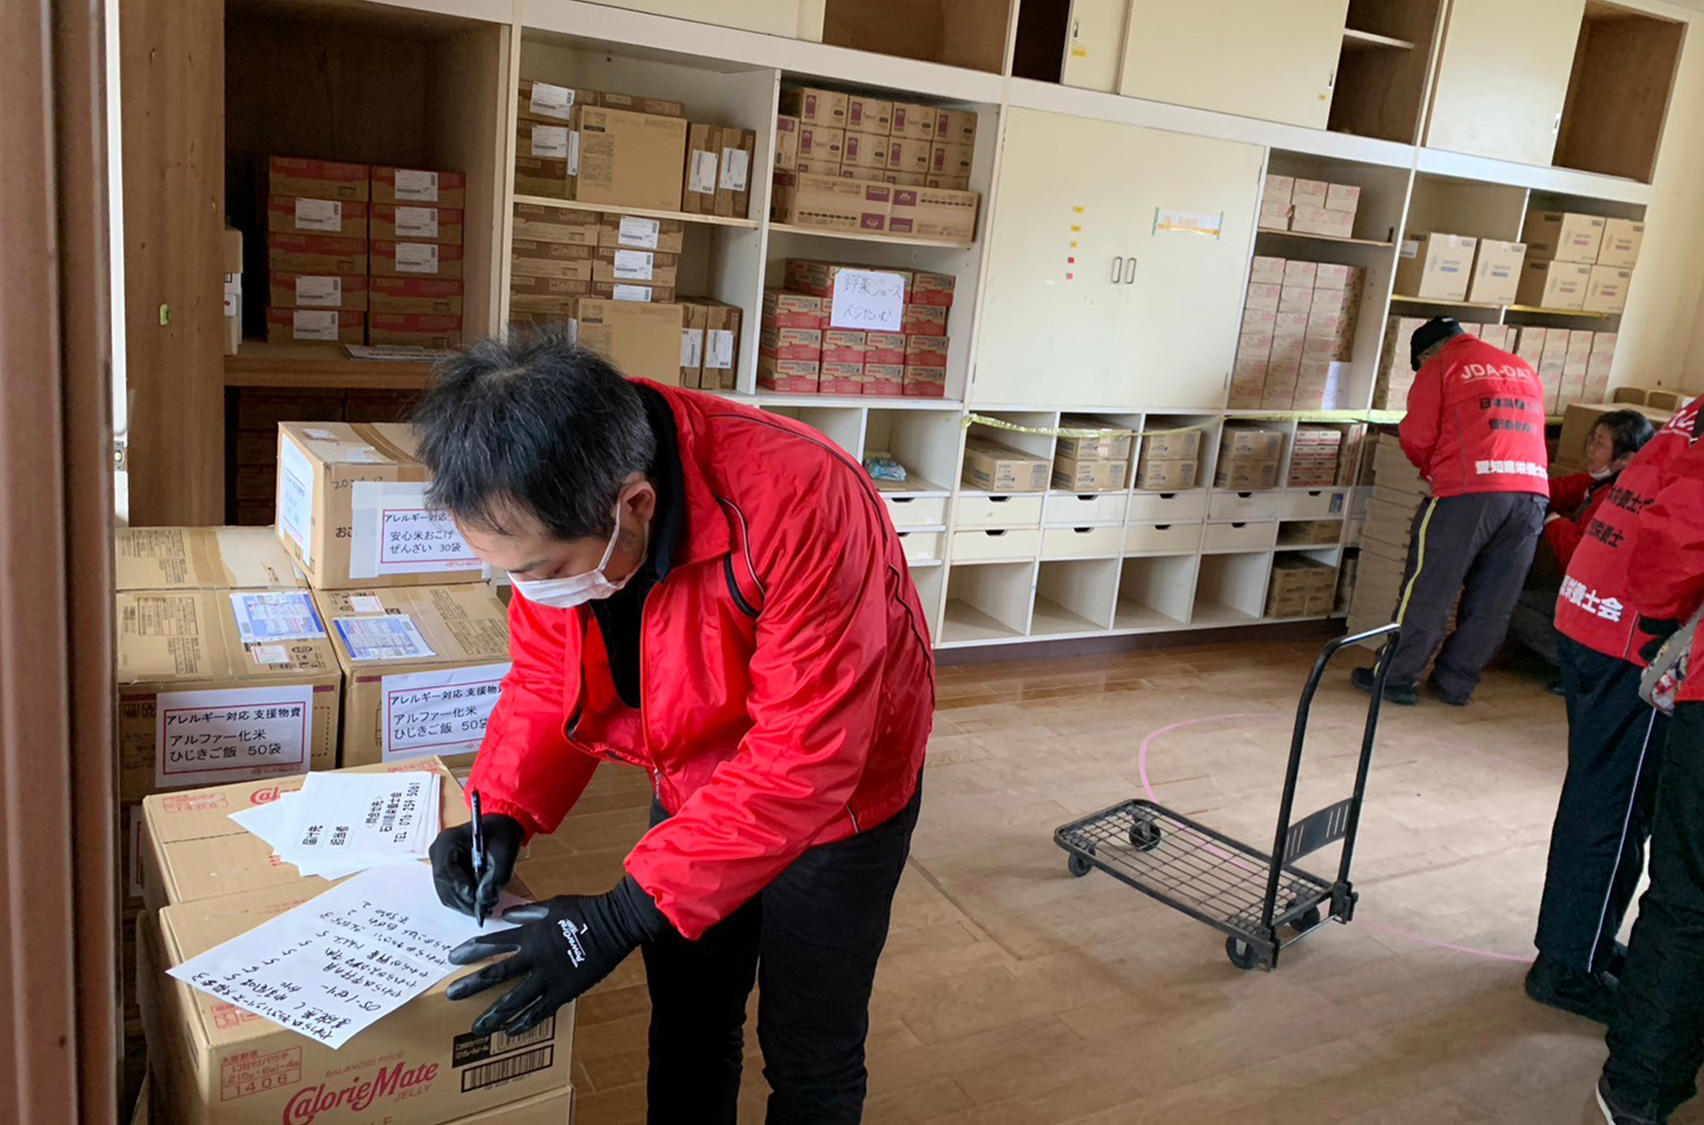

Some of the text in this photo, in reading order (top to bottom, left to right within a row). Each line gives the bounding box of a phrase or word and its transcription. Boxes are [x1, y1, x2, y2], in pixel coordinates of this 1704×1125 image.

[390, 543, 462, 555] ぜんざい 30袋
[391, 691, 463, 706] アレルギー対応
[167, 706, 301, 726] アレルギー対応 支援物資
[394, 705, 478, 725] アルファー化米
[170, 728, 266, 747] アルファー化米
[394, 722, 453, 740] ひじきご飯
[170, 742, 282, 763] ひじきご飯 50袋
[580, 923, 588, 934] L
[235, 1073, 288, 1095] 1406
[283, 1061, 439, 1125] CalorieMate
